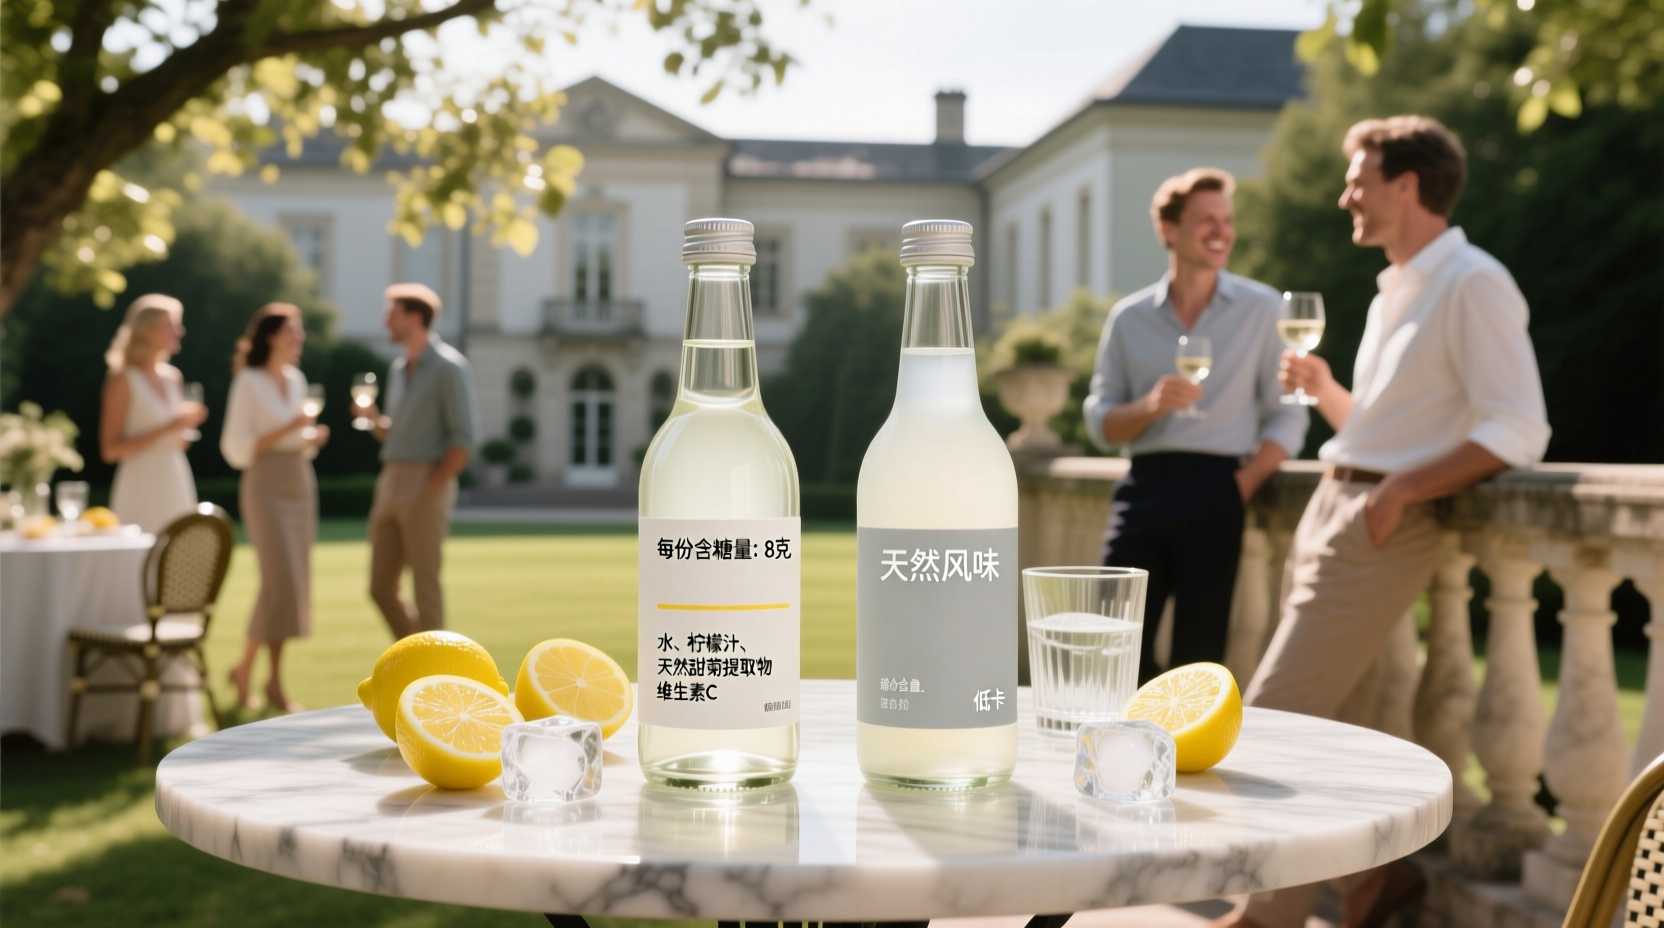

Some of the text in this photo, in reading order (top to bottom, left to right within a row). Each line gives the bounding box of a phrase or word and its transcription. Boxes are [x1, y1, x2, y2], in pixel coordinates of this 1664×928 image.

[880, 547, 1000, 582] 天然风味
[656, 681, 718, 702] 维生素C
[973, 687, 1006, 713] 低卡
